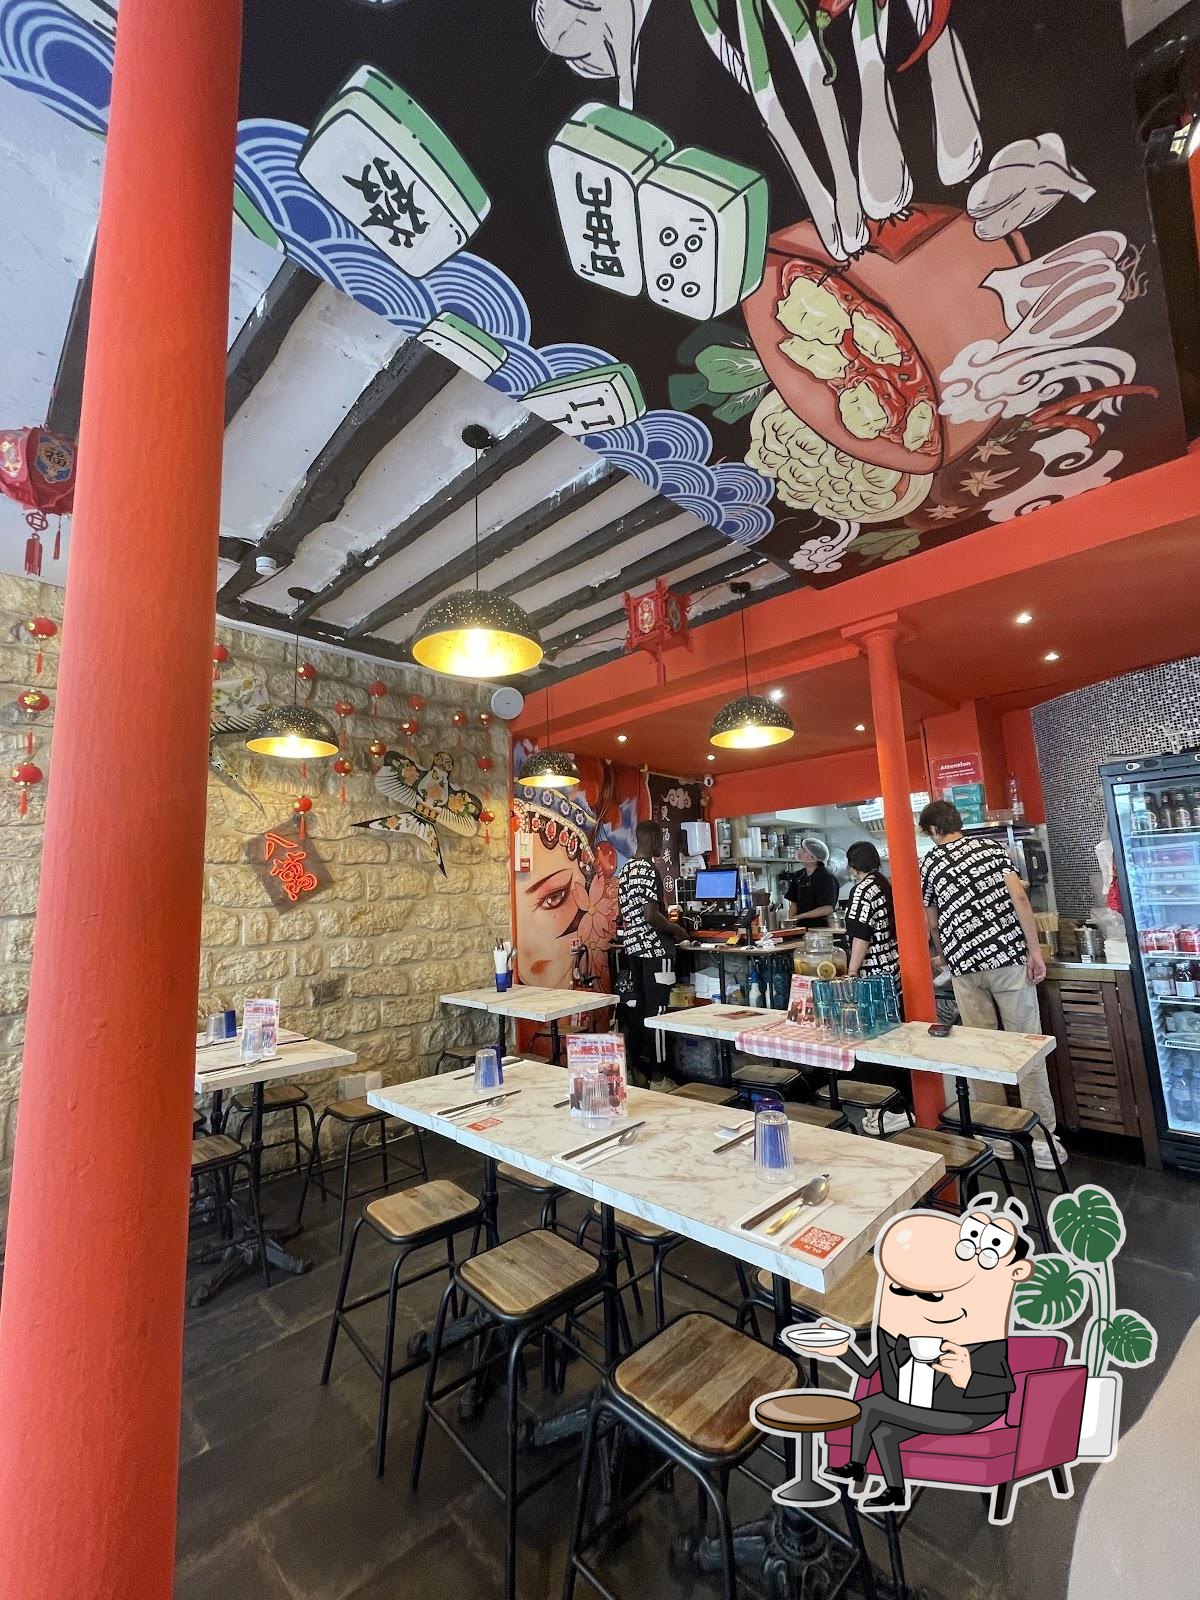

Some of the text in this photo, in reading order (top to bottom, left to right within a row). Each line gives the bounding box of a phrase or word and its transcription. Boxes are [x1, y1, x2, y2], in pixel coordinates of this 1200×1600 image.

[939, 761, 971, 771] Attention
[948, 922, 1002, 966] Trantranzai
[959, 942, 999, 972] Service
